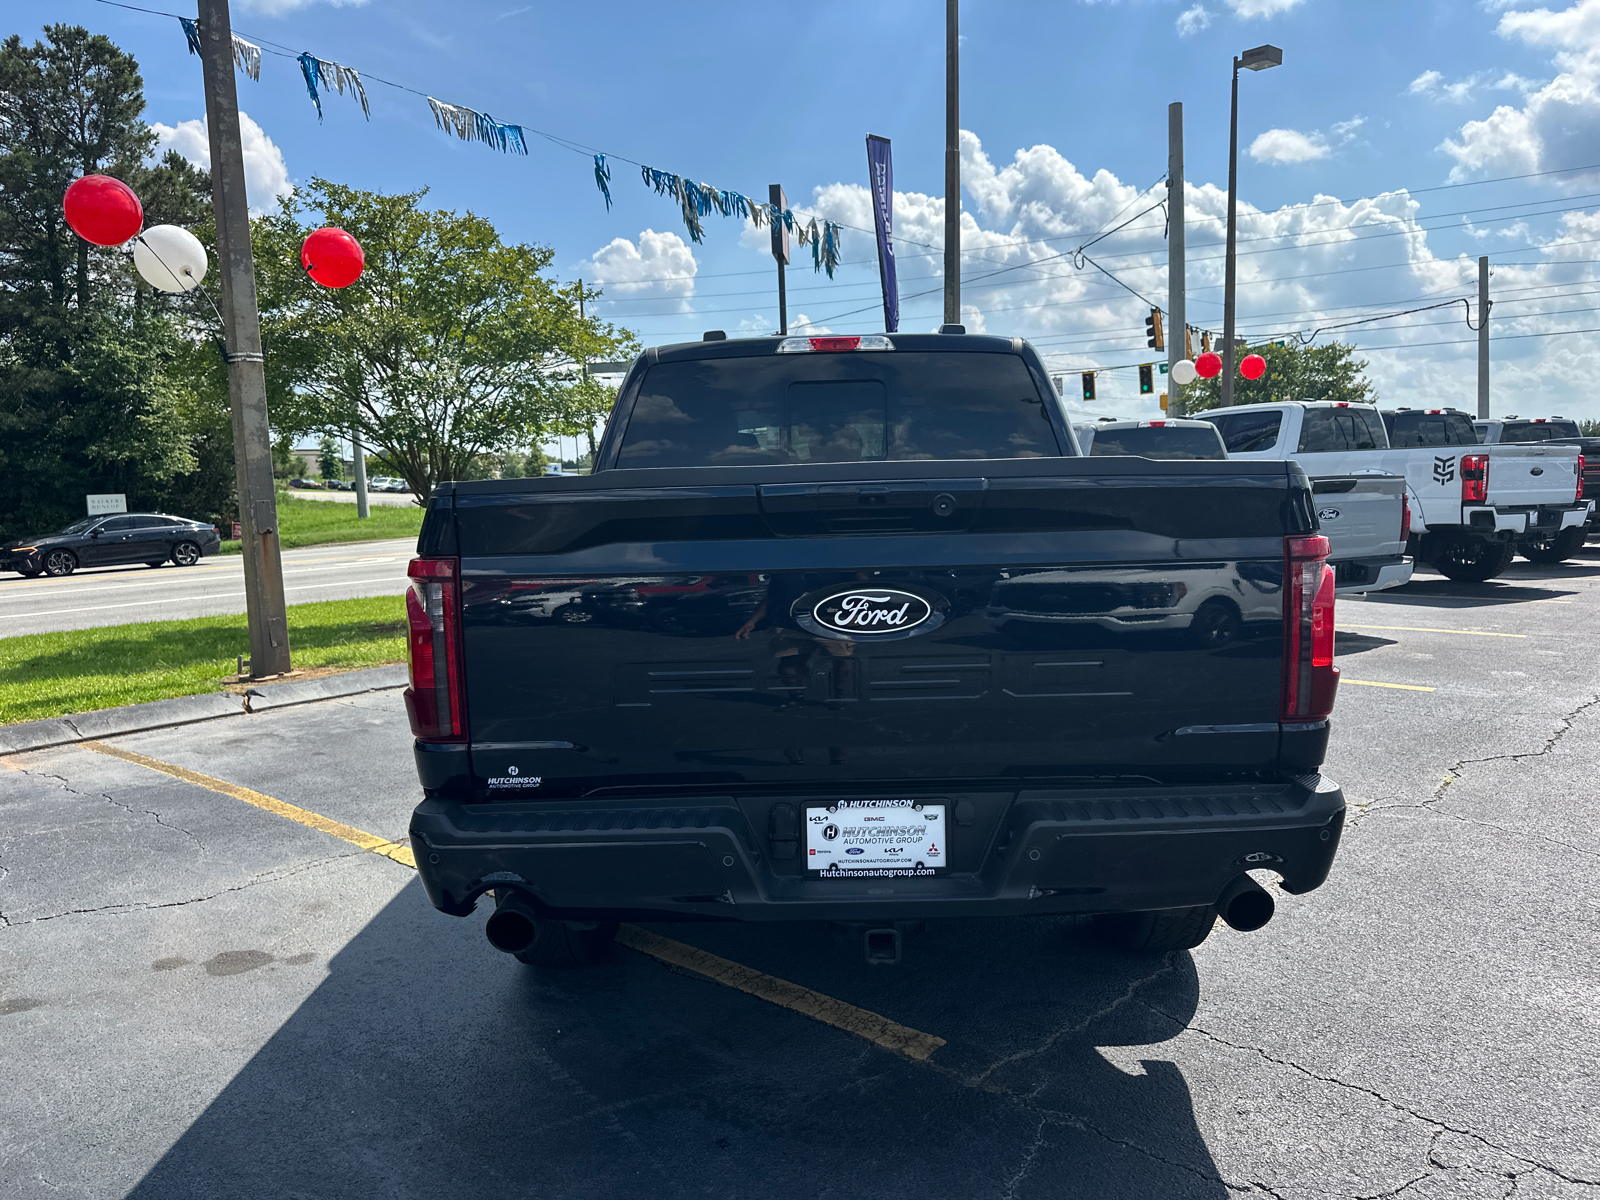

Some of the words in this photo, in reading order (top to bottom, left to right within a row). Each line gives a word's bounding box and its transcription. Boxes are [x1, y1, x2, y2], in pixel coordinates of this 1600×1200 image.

[834, 595, 910, 626] Ford
[850, 800, 914, 808] HUTCHINSON
[842, 825, 927, 838] HUTCHINSON
[843, 837, 894, 845] AUTOMOTIVE
[895, 836, 923, 844] GROUP
[820, 868, 935, 877] Hutchinsonautogroup.com
